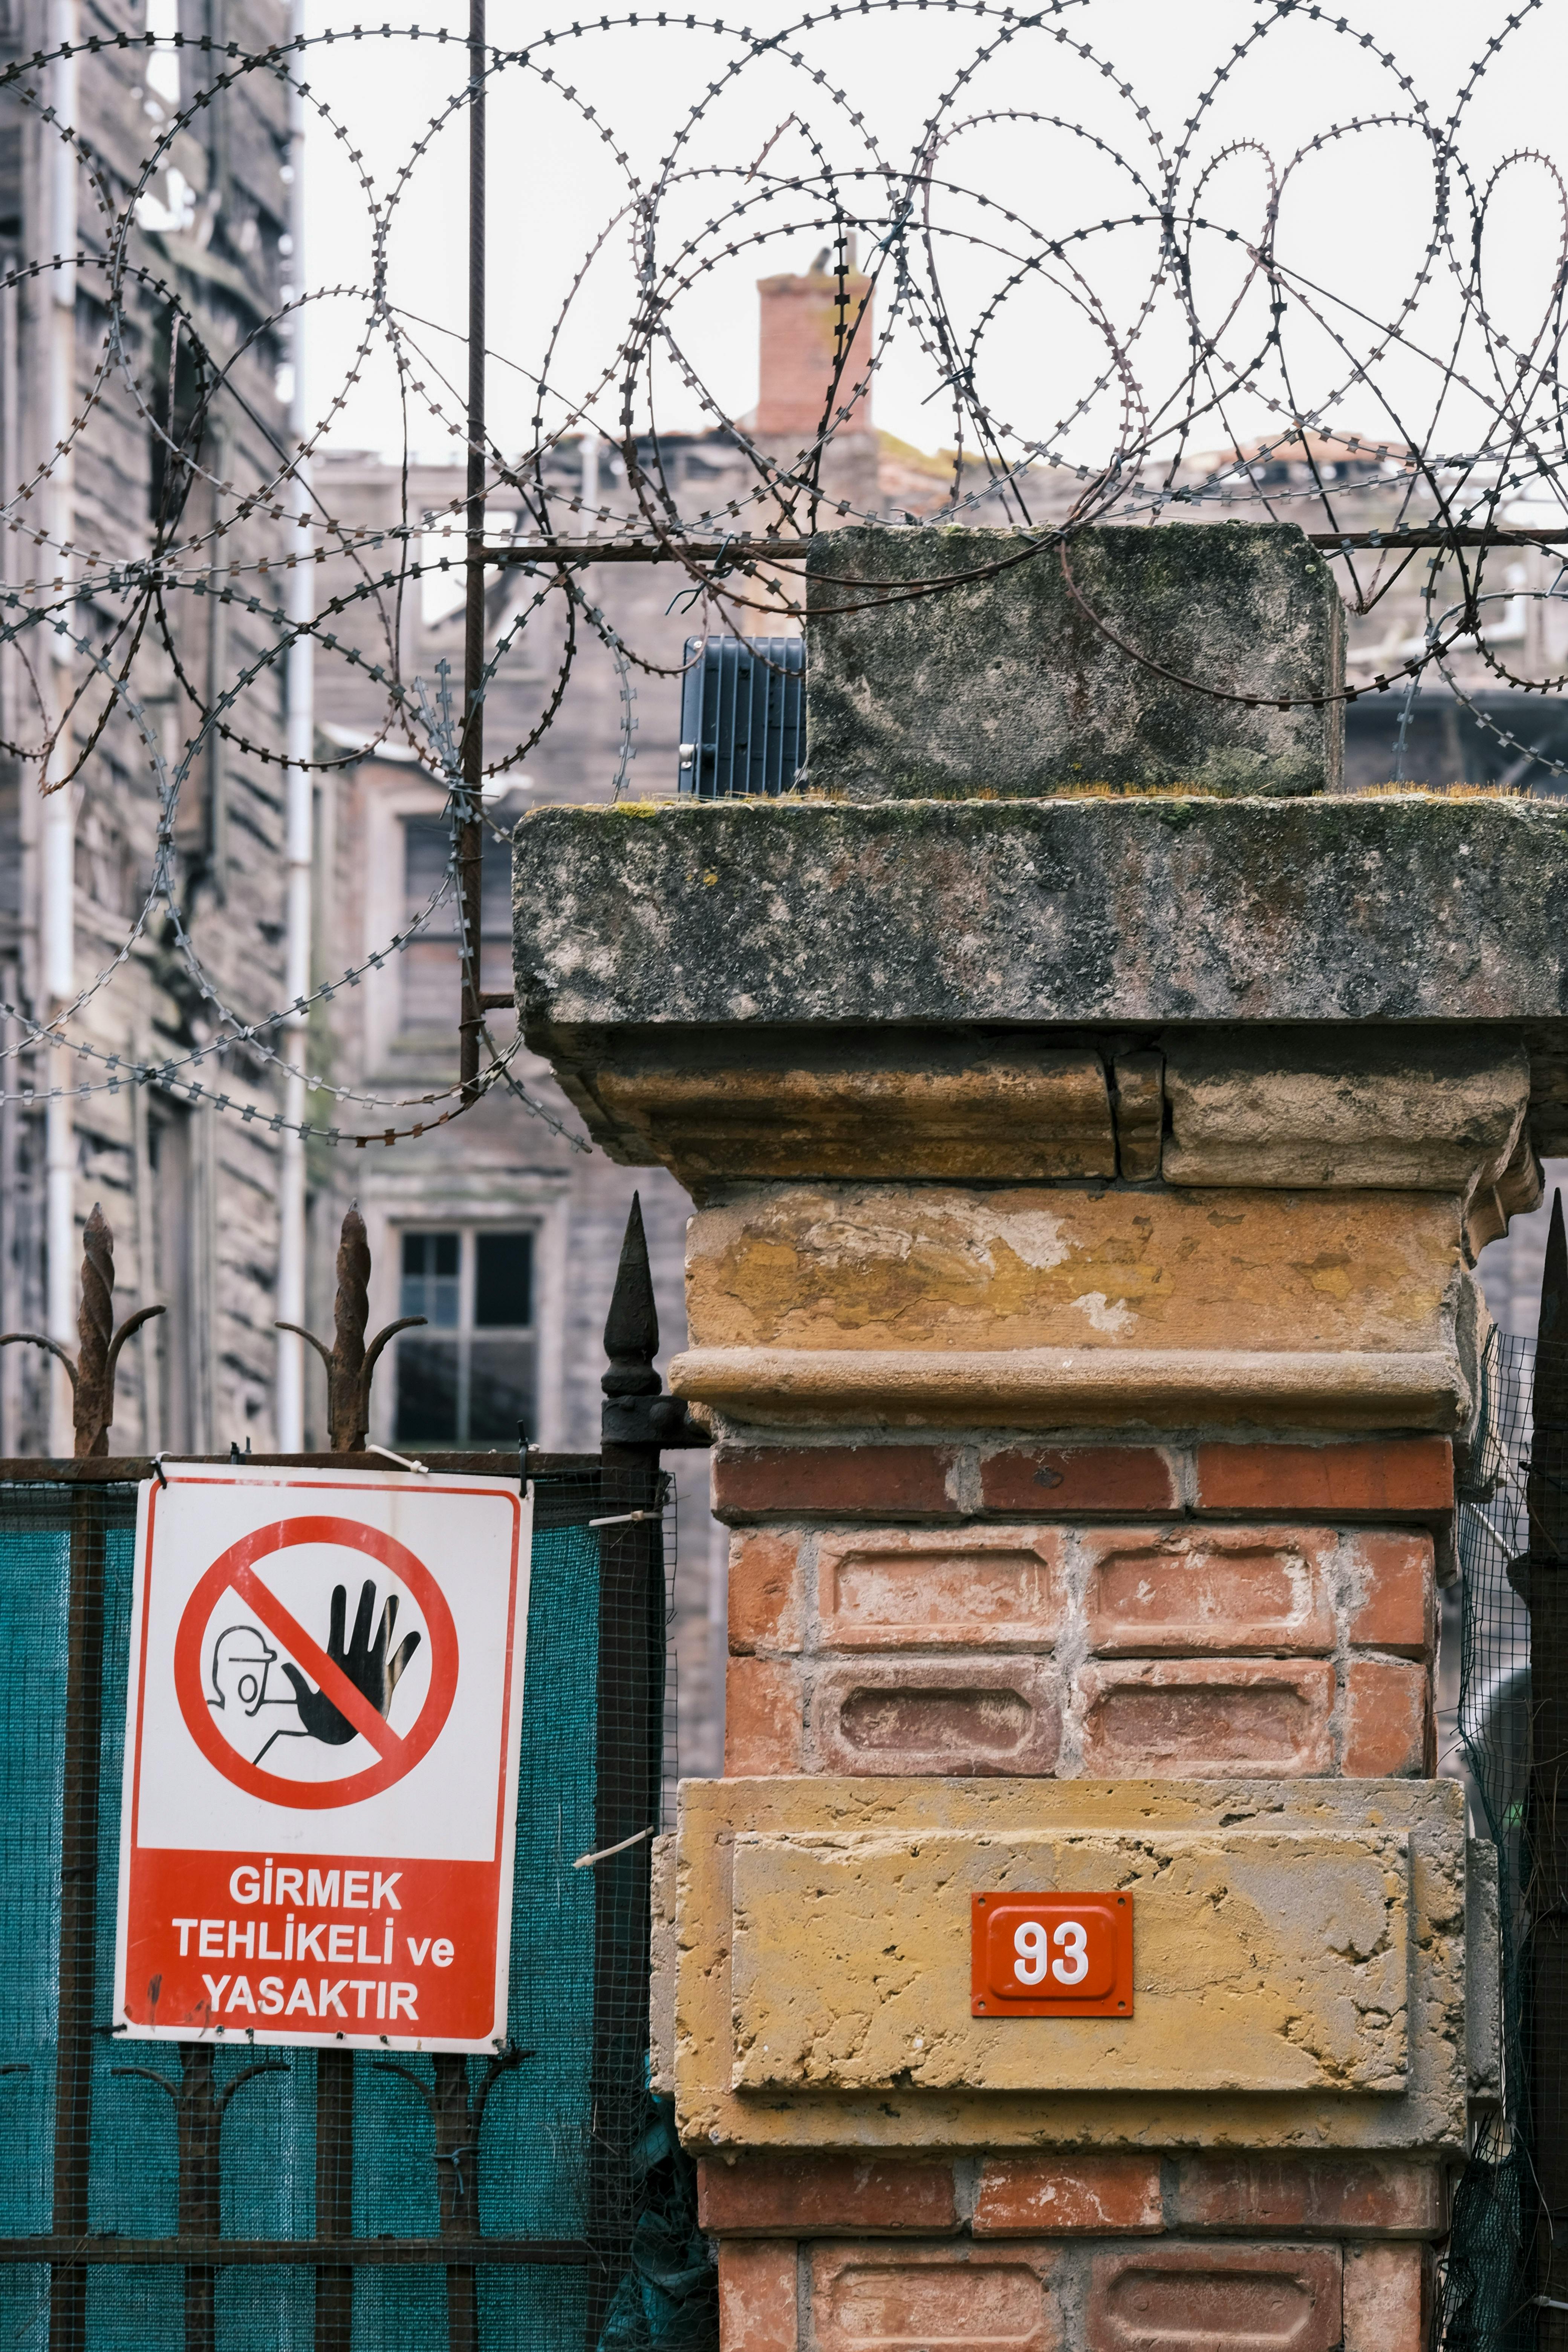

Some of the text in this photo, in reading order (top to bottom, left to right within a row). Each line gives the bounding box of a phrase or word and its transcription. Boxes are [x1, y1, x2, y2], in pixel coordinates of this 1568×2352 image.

[229, 1857, 403, 1910] GİRMEK
[172, 1913, 454, 1967] TEHLİKELİ ve
[1014, 1921, 1089, 1985] 93
[202, 1974, 419, 2020] YASAKTIR
